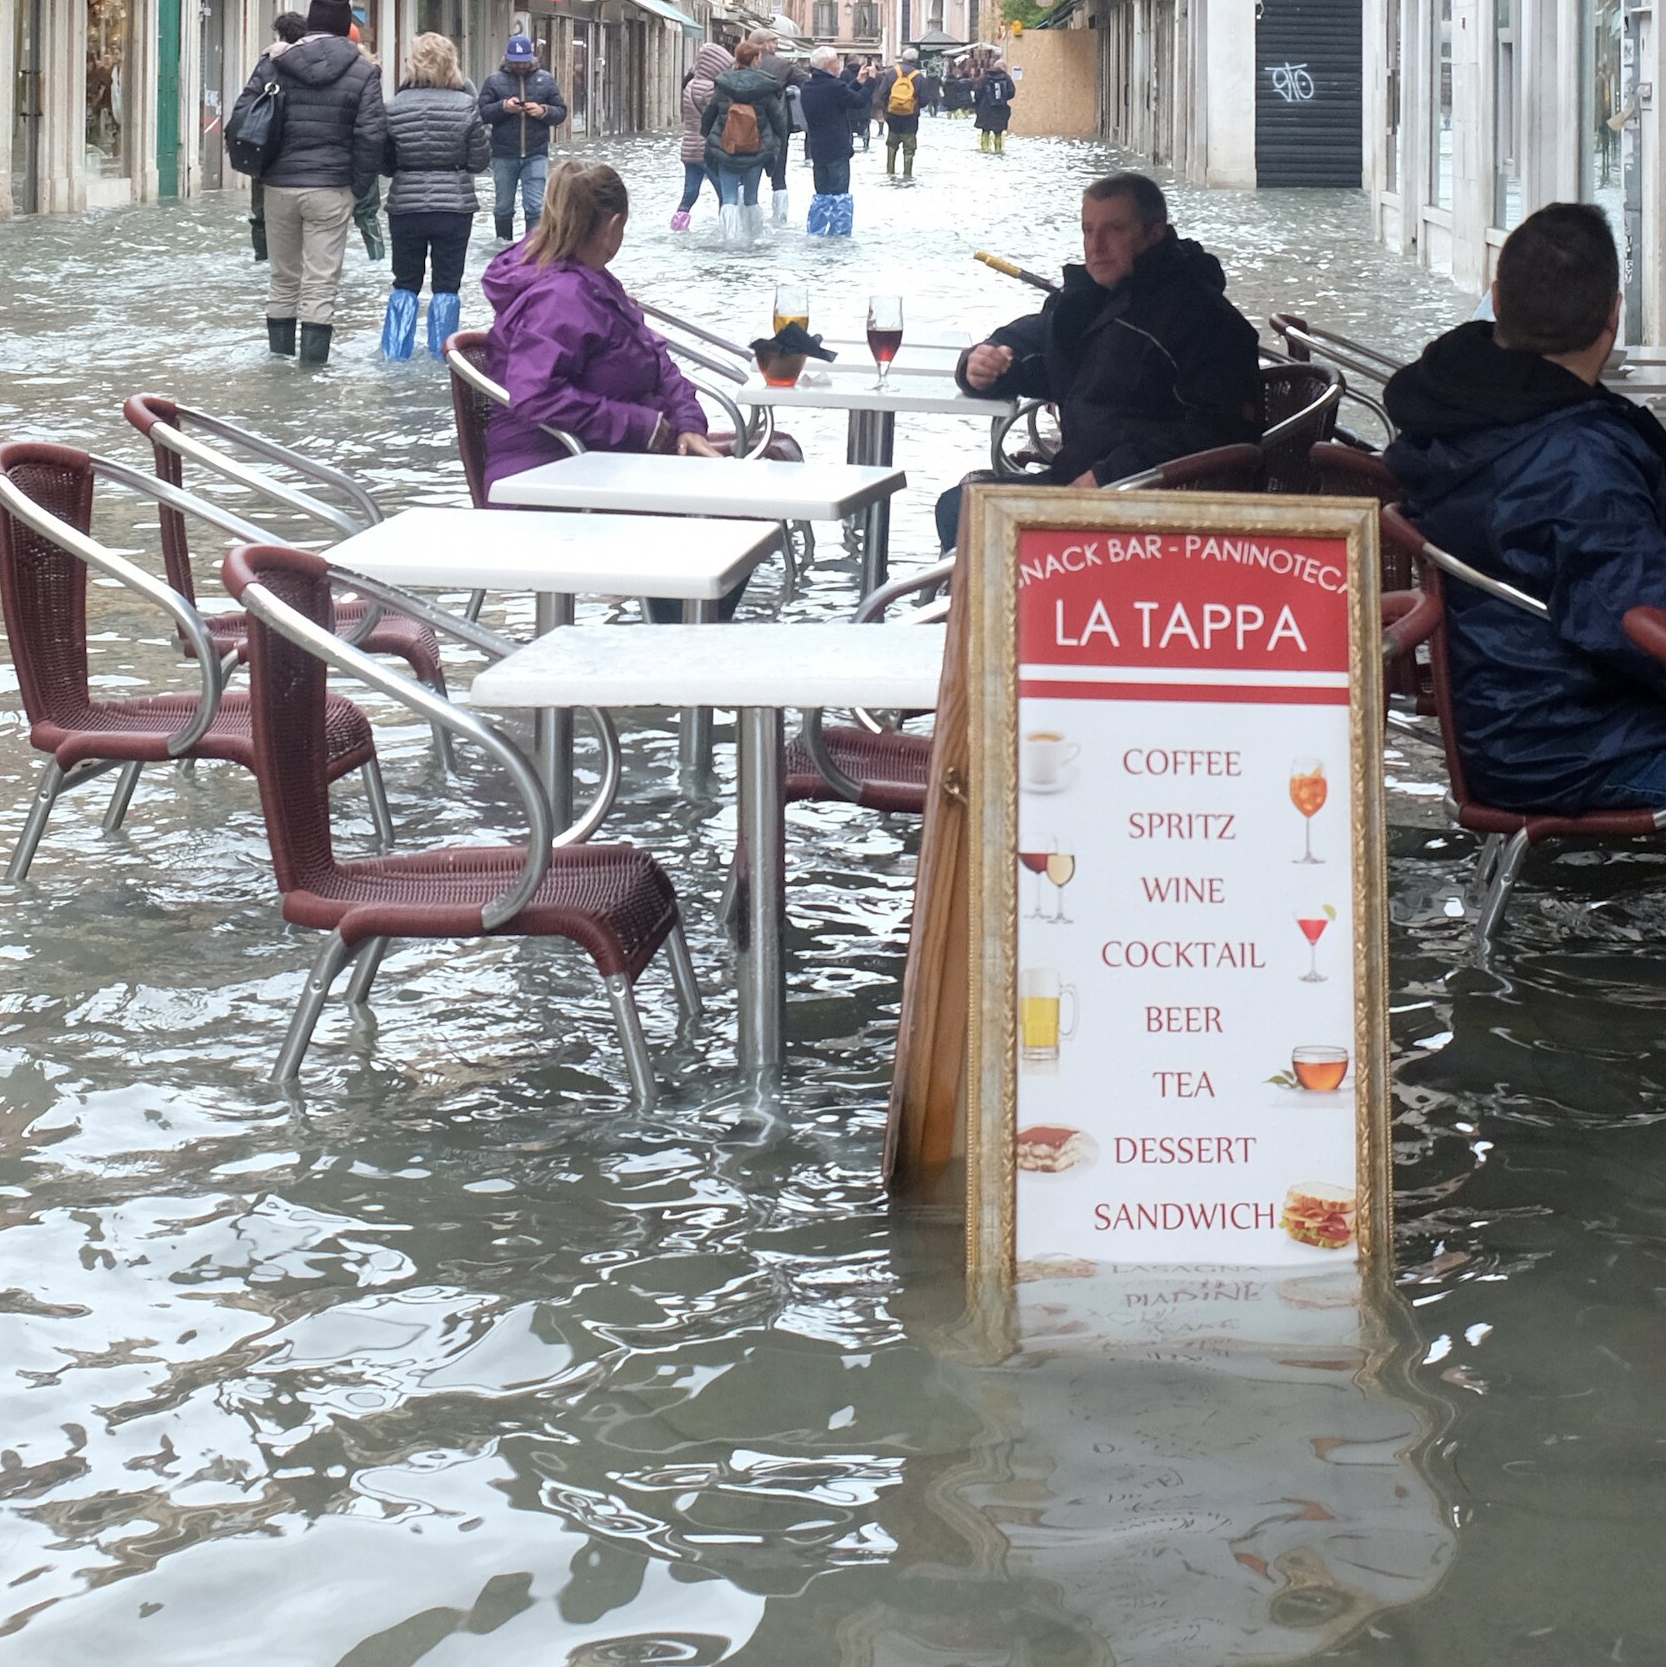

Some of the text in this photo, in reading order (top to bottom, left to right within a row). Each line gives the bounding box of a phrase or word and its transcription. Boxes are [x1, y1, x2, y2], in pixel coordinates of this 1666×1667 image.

[1107, 535, 1163, 563] BAR
[1055, 598, 1308, 653] LA TAPPA
[1122, 747, 1243, 777] COFFEE
[1128, 811, 1237, 840] SPRITZ
[1139, 876, 1226, 904] WINE
[1101, 940, 1267, 969] COCKTAIL
[1144, 1005, 1224, 1034] BEER
[1152, 1070, 1216, 1098] TEA
[1113, 1136, 1257, 1165] DESSERT
[1093, 1201, 1275, 1231] SANDWICH
[1111, 1263, 1263, 1275] LASAGNA
[1125, 1280, 1263, 1309] PIADINE
